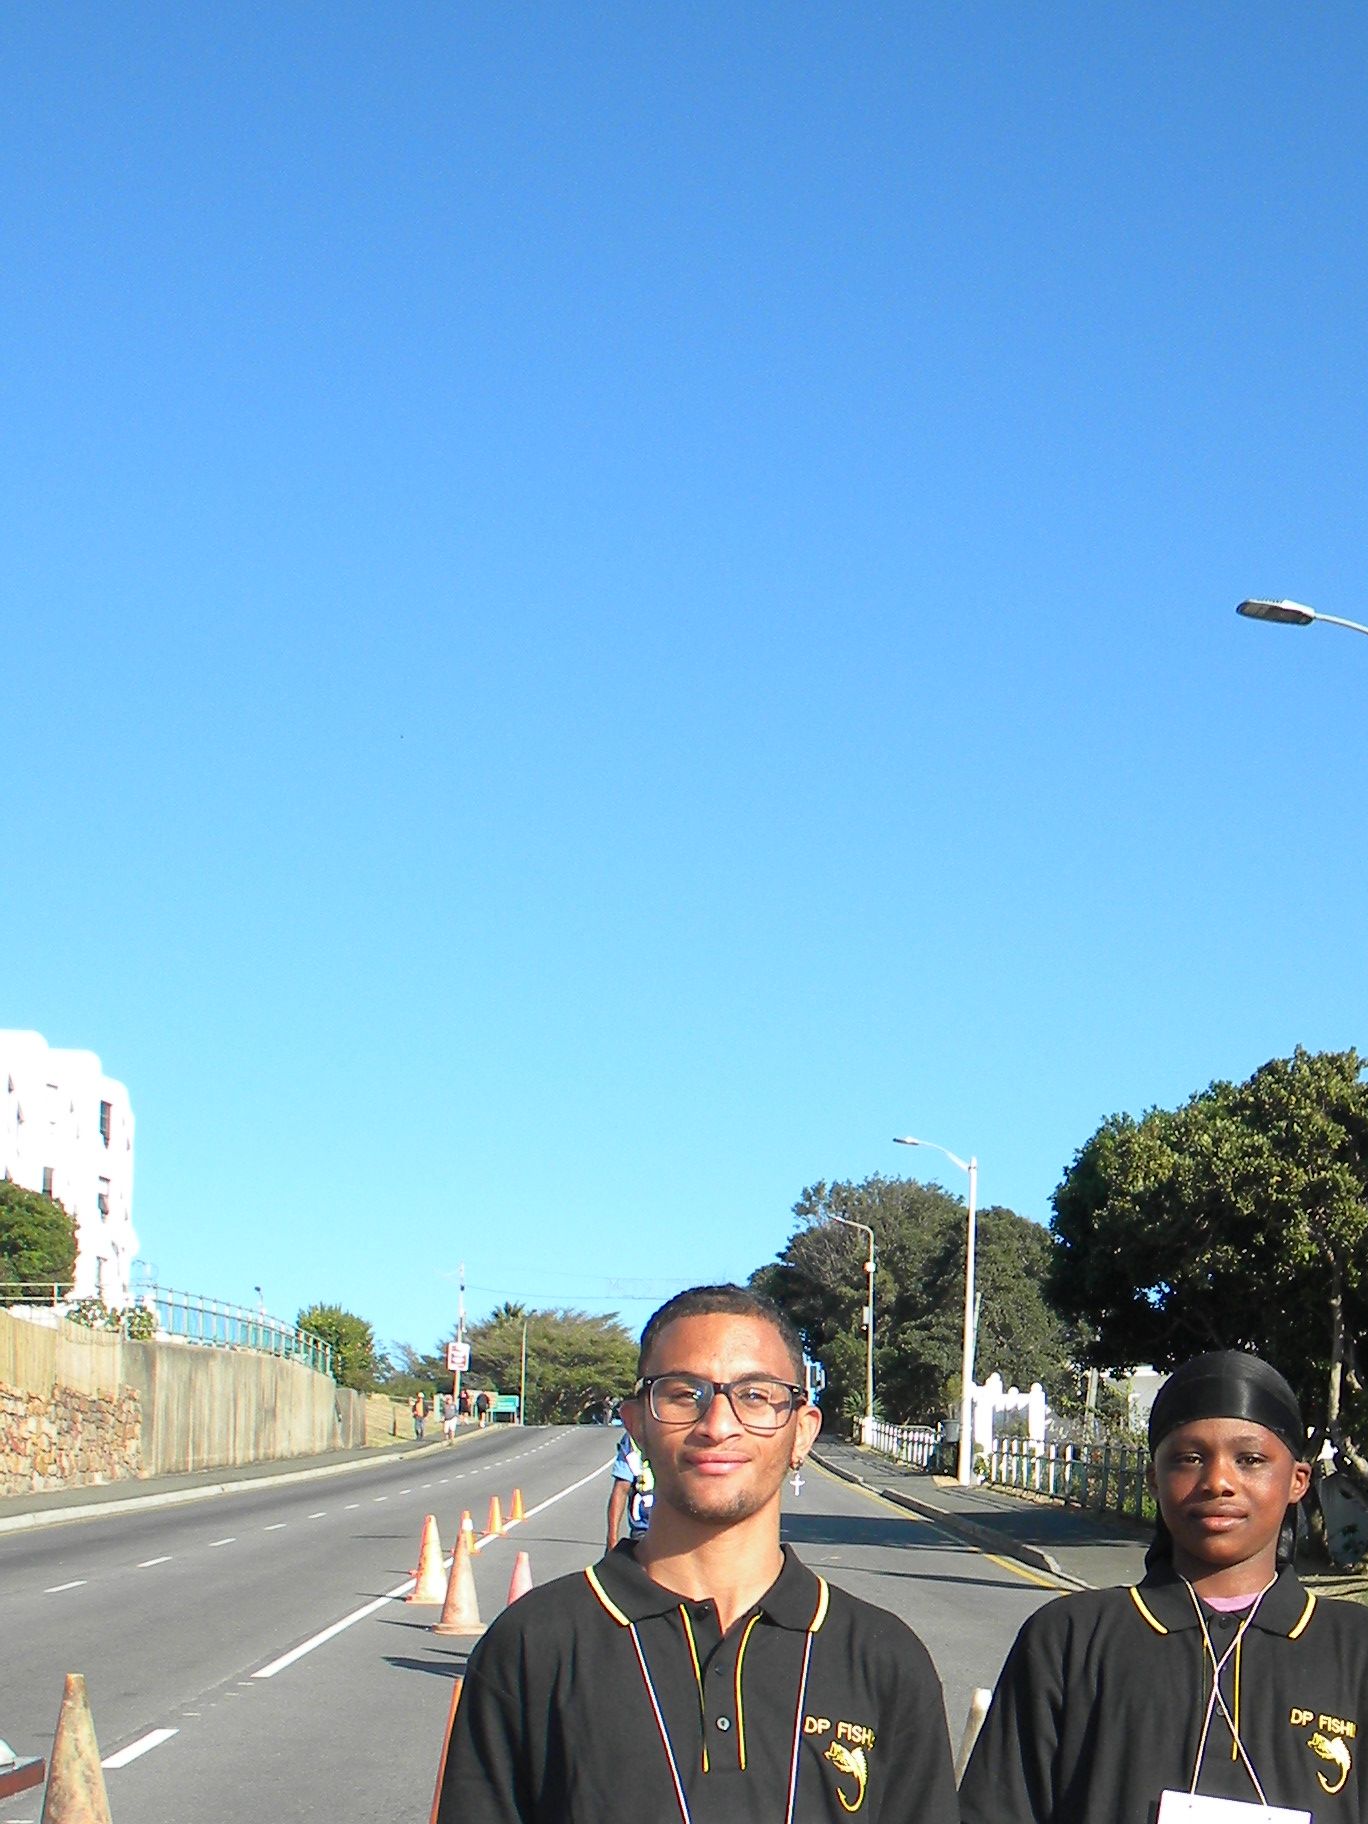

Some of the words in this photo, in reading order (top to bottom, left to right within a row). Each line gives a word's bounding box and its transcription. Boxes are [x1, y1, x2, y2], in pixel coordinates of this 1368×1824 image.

[1290, 1707, 1314, 1726] DP
[803, 1715, 831, 1735] DP
[836, 1721, 875, 1750] FISH
